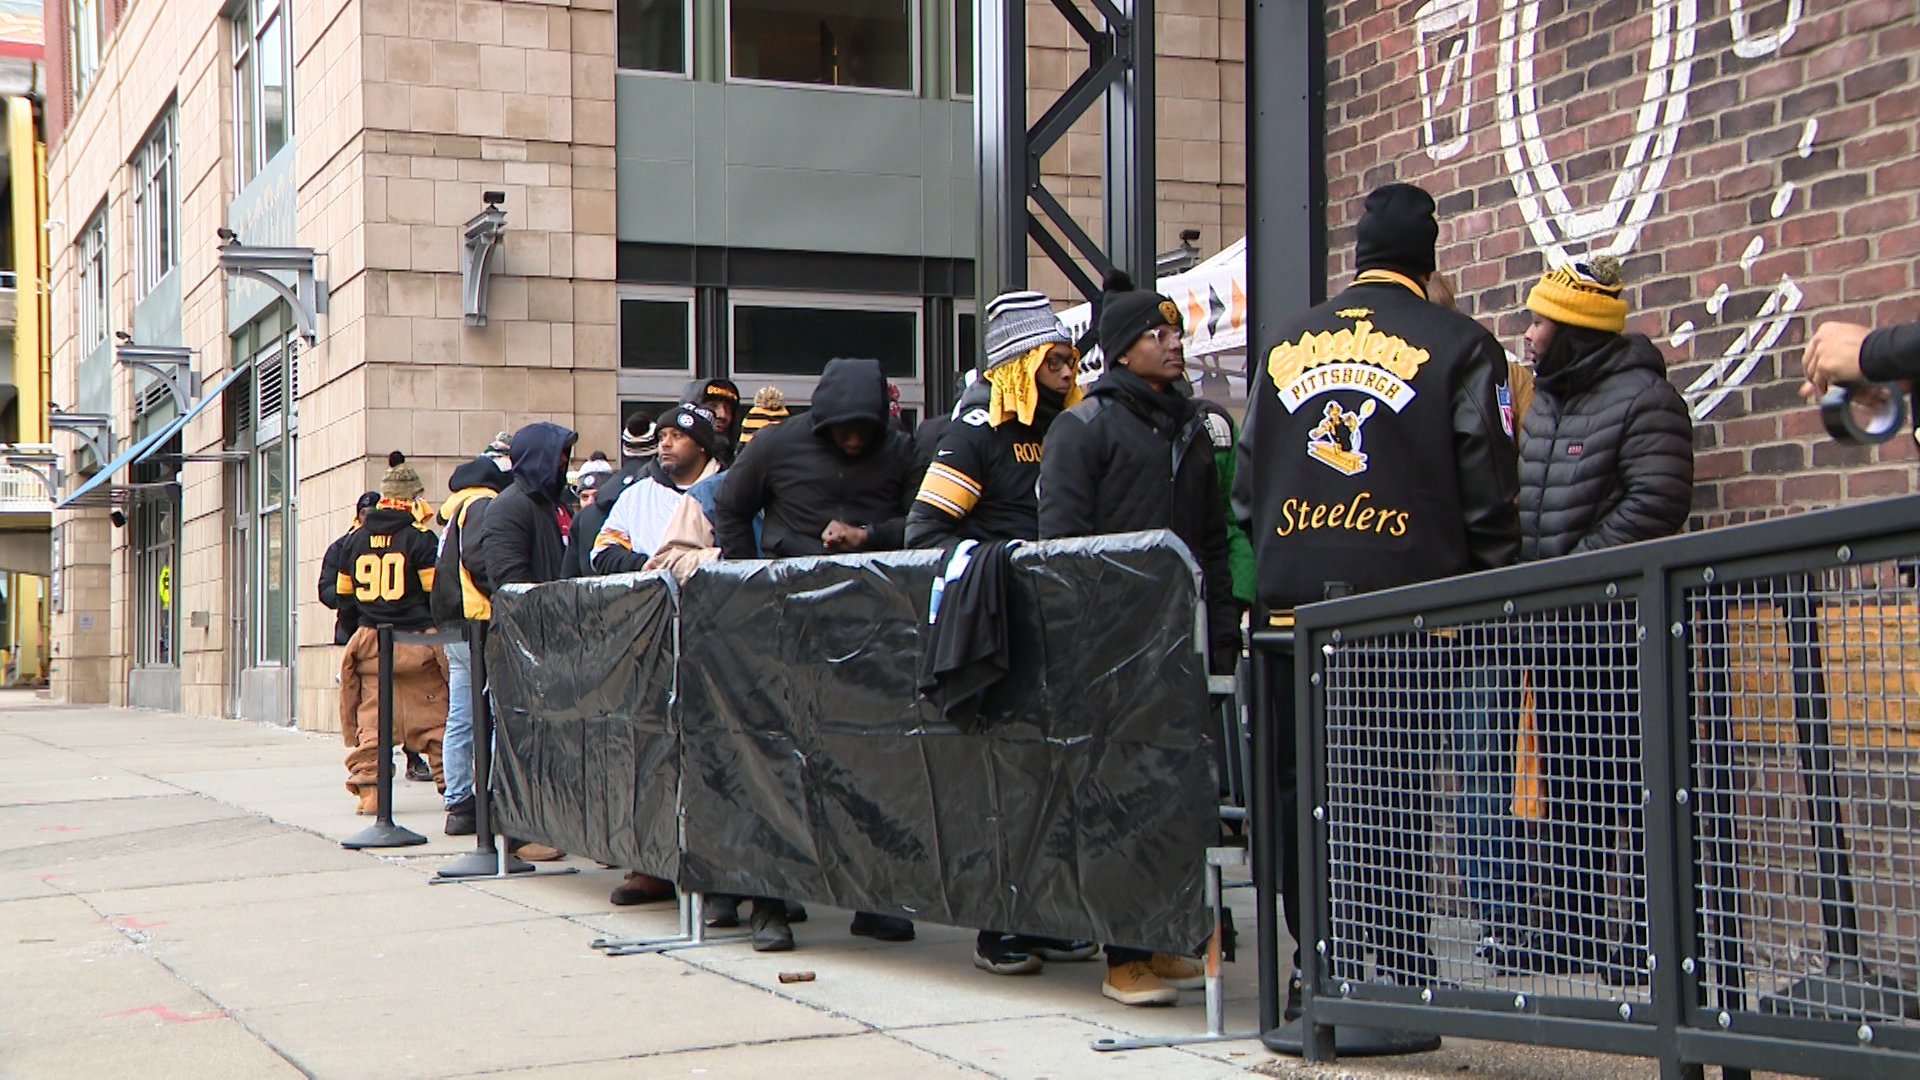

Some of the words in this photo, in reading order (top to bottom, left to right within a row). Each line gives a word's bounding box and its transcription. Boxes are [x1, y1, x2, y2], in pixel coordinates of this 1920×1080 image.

[1268, 319, 1431, 391] Steelers
[1291, 367, 1402, 401] PITTSBURGH
[1276, 492, 1410, 537] Steelers
[355, 553, 405, 601] 90
